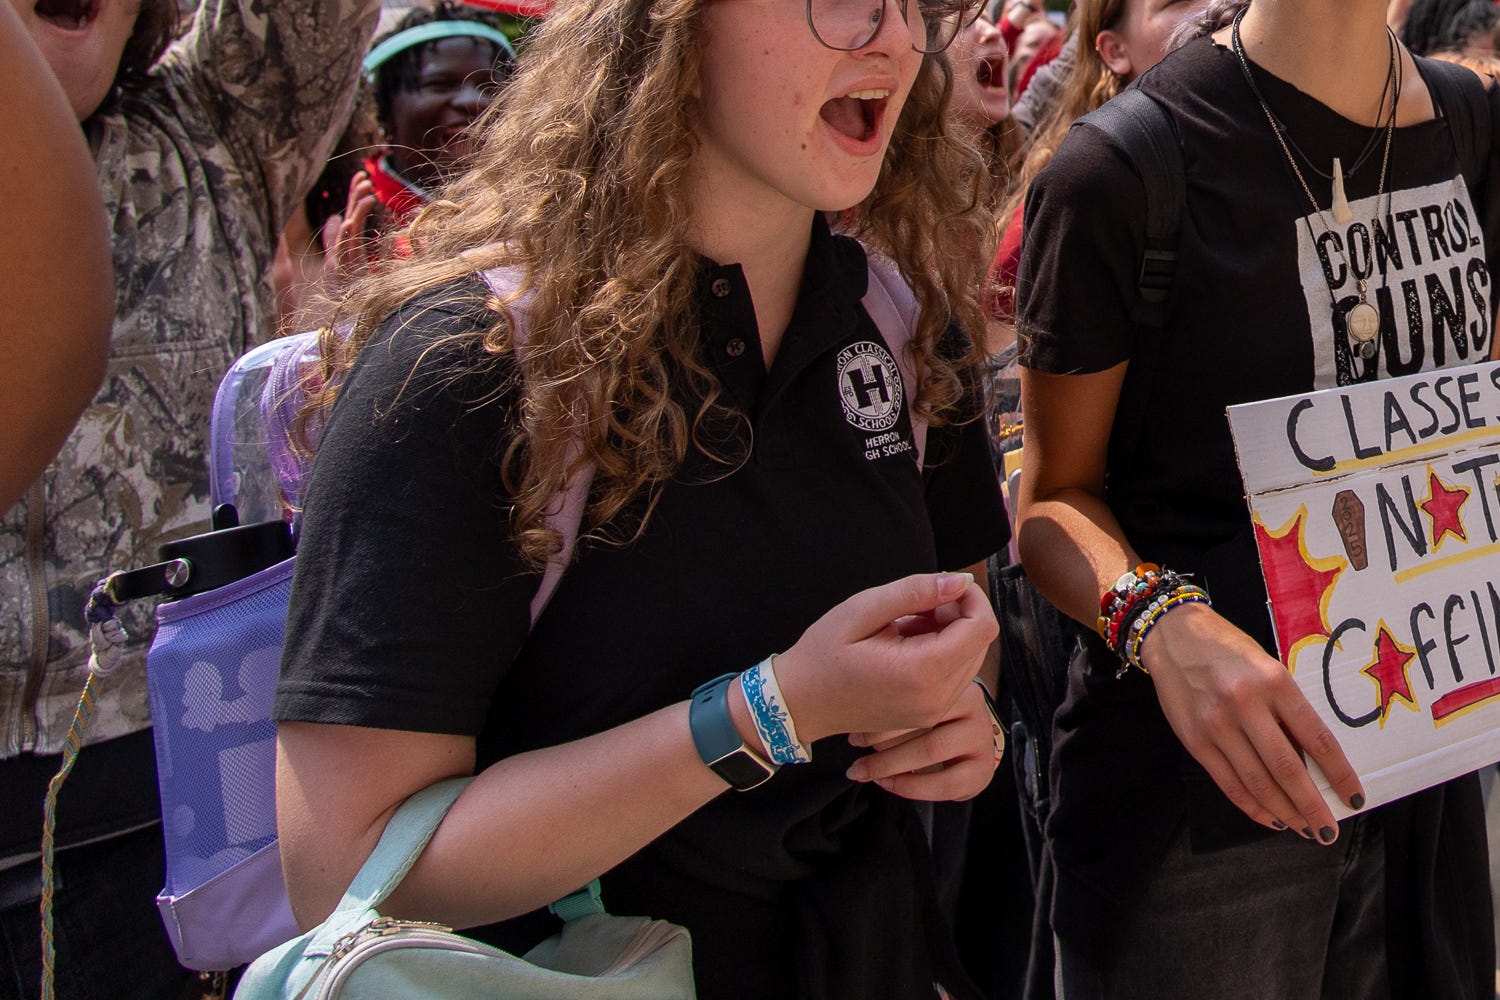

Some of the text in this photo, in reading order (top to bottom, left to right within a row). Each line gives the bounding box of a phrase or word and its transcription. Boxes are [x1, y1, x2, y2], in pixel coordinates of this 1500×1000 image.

[1317, 198, 1481, 290] CONTROL
[1331, 257, 1489, 387] GUNS
[854, 343, 897, 374] CLASSICAL
[858, 409, 897, 430] SCHOOLS
[865, 431, 900, 449] HERRON
[865, 440, 912, 461] GH SCHOOL
[1376, 455, 1500, 571] NT
